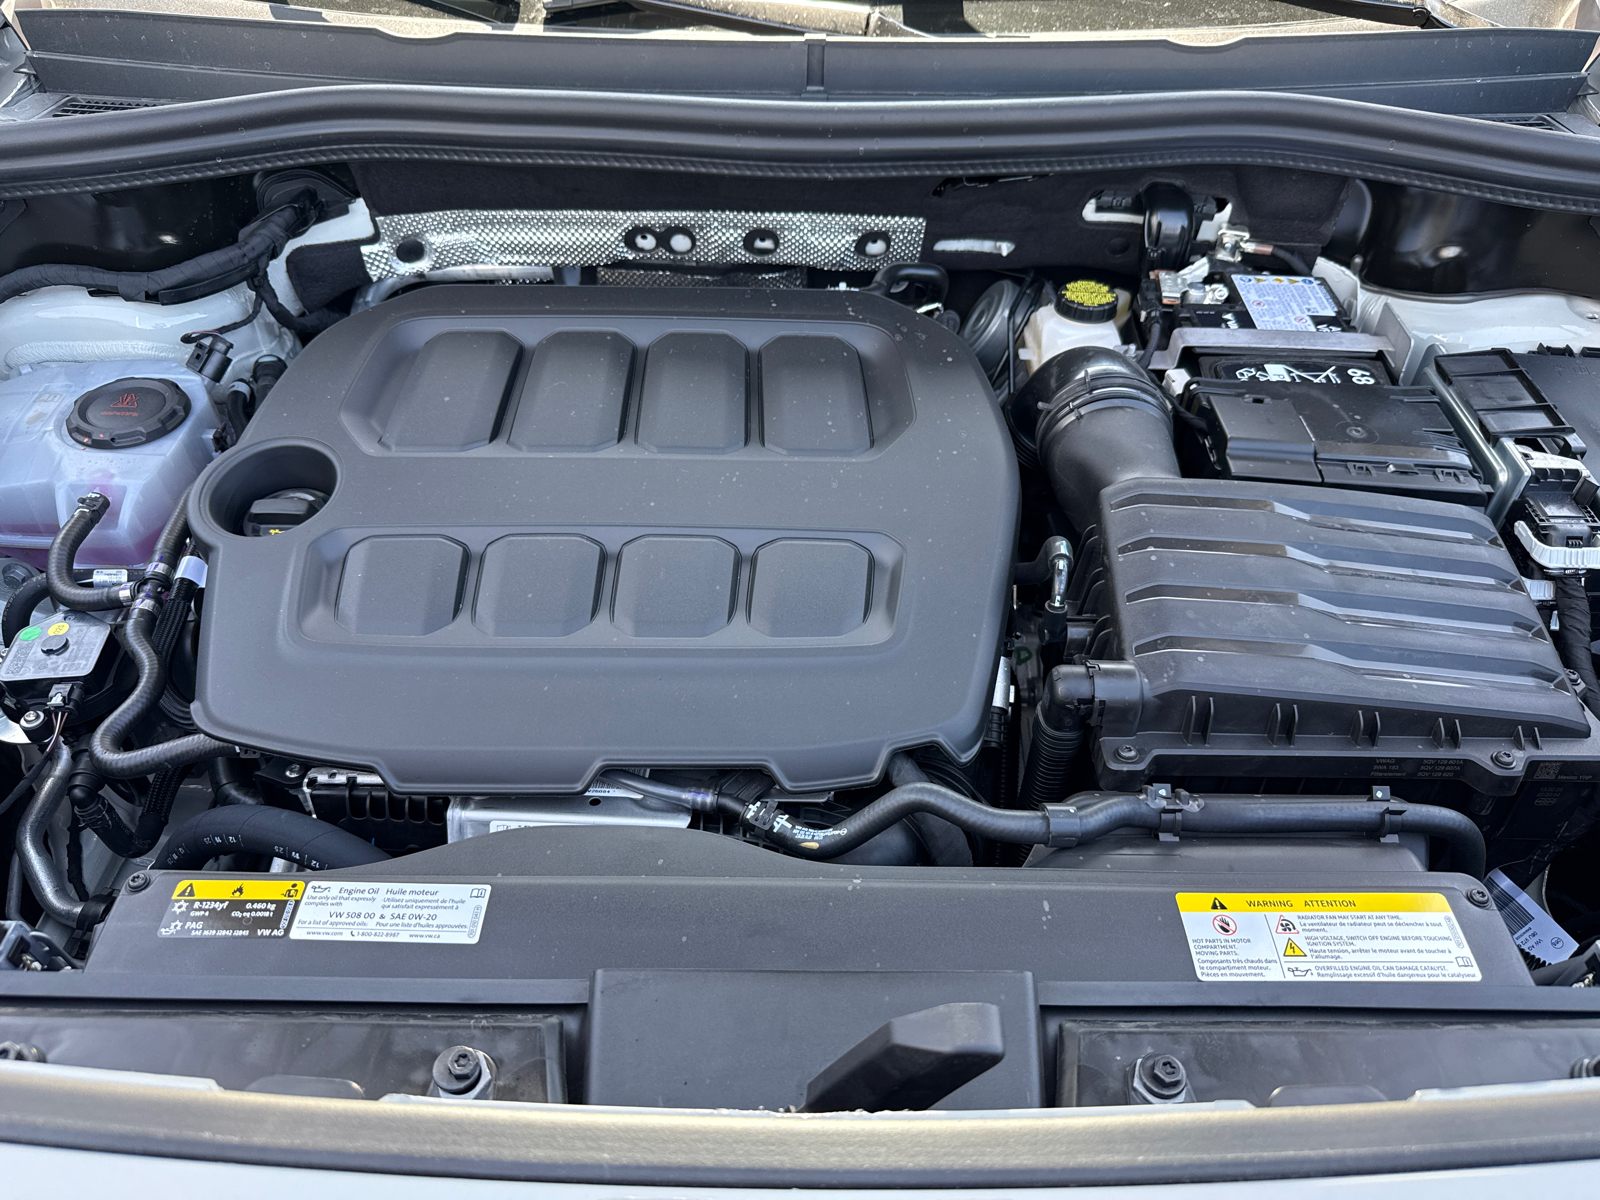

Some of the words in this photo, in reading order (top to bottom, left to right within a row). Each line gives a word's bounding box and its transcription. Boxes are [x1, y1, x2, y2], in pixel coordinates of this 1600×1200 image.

[1347, 368, 1375, 384] 68
[339, 887, 366, 895] Engine
[193, 901, 229, 910] R-1234yf
